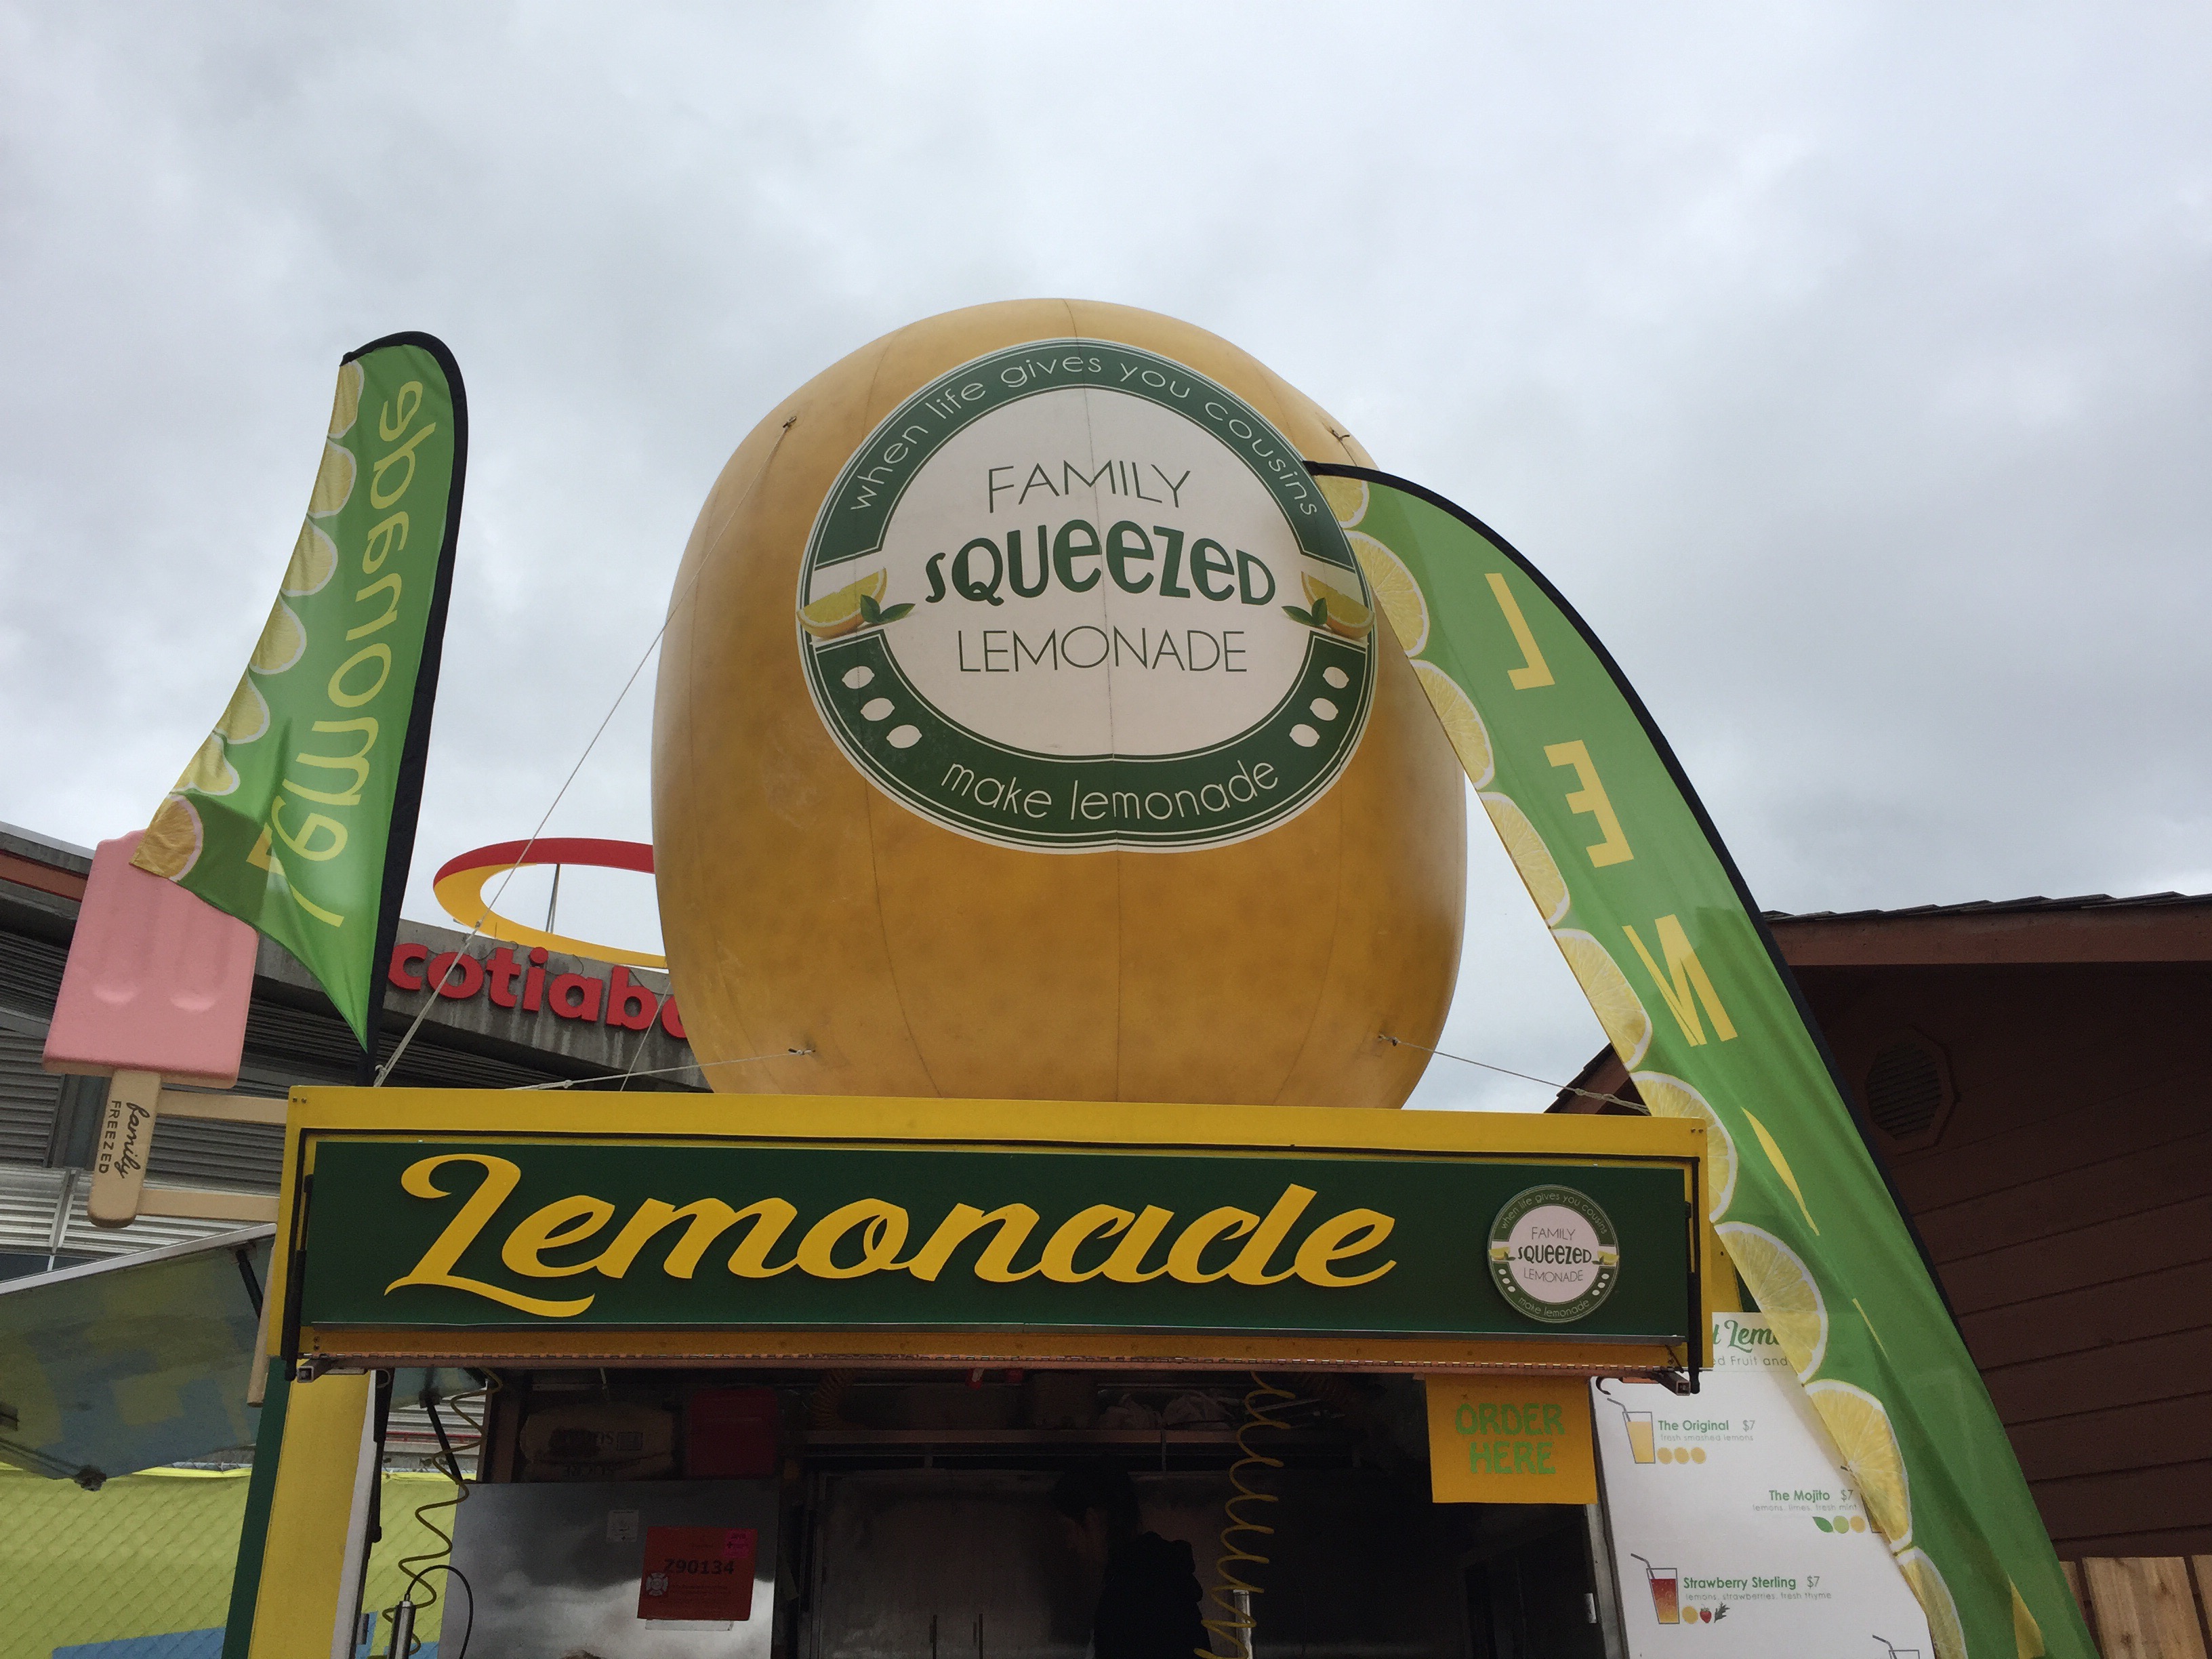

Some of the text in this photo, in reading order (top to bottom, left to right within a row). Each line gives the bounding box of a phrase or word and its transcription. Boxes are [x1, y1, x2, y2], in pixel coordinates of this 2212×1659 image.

[850, 356, 1317, 516] when life gives you cousins
[988, 459, 1191, 514] FAMILY
[958, 626, 1248, 673] LEMONADE
[941, 759, 1279, 821] make lemonade
[98, 1100, 122, 1174] FREEZED
[1501, 1193, 1607, 1234] when life gives you cousins
[384, 1154, 1397, 1317] Lemonade
[1532, 1227, 1576, 1241] FAMILY
[1523, 1267, 1584, 1283] LEMONADE
[1518, 1297, 1590, 1317] make lemonade
[1731, 1355, 1757, 1366] Fruit
[1763, 1355, 1788, 1366] and
[1456, 1402, 1565, 1435] ORDER
[1658, 1420, 1755, 1433] The Original $7
[1723, 1433, 1754, 1441] lemons
[1469, 1441, 1557, 1474] HERE
[1769, 1489, 1854, 1503] The Mojito $7
[1683, 1575, 1820, 1591] Strawberry Sterling $7
